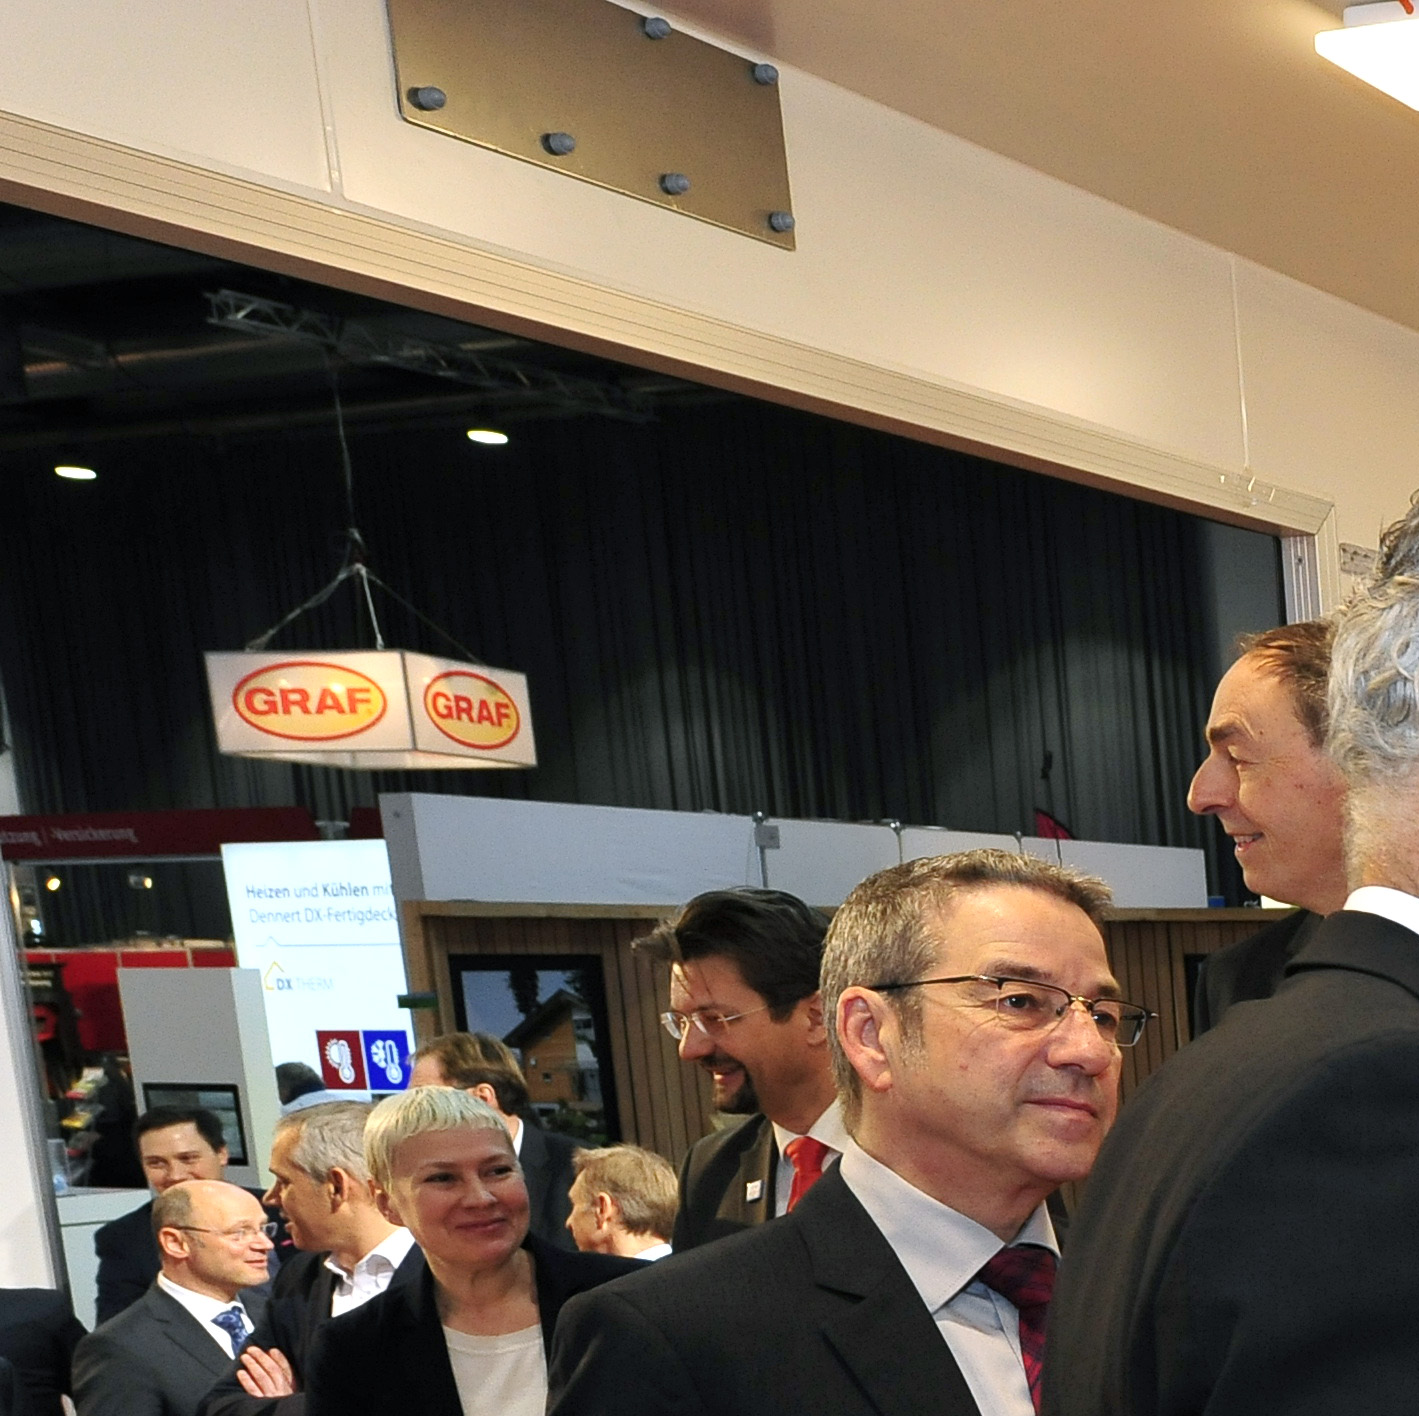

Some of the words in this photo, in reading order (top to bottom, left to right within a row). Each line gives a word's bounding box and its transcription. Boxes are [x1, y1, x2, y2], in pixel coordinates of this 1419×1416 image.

[244, 686, 372, 716] GRAF
[432, 691, 512, 727] GRAF
[245, 885, 290, 899] Heizen
[293, 884, 319, 898] und
[322, 882, 369, 898] Kühlen
[249, 908, 302, 924] Dennert
[304, 905, 398, 926] DX-Fertigdeck
[276, 978, 293, 991] DX
